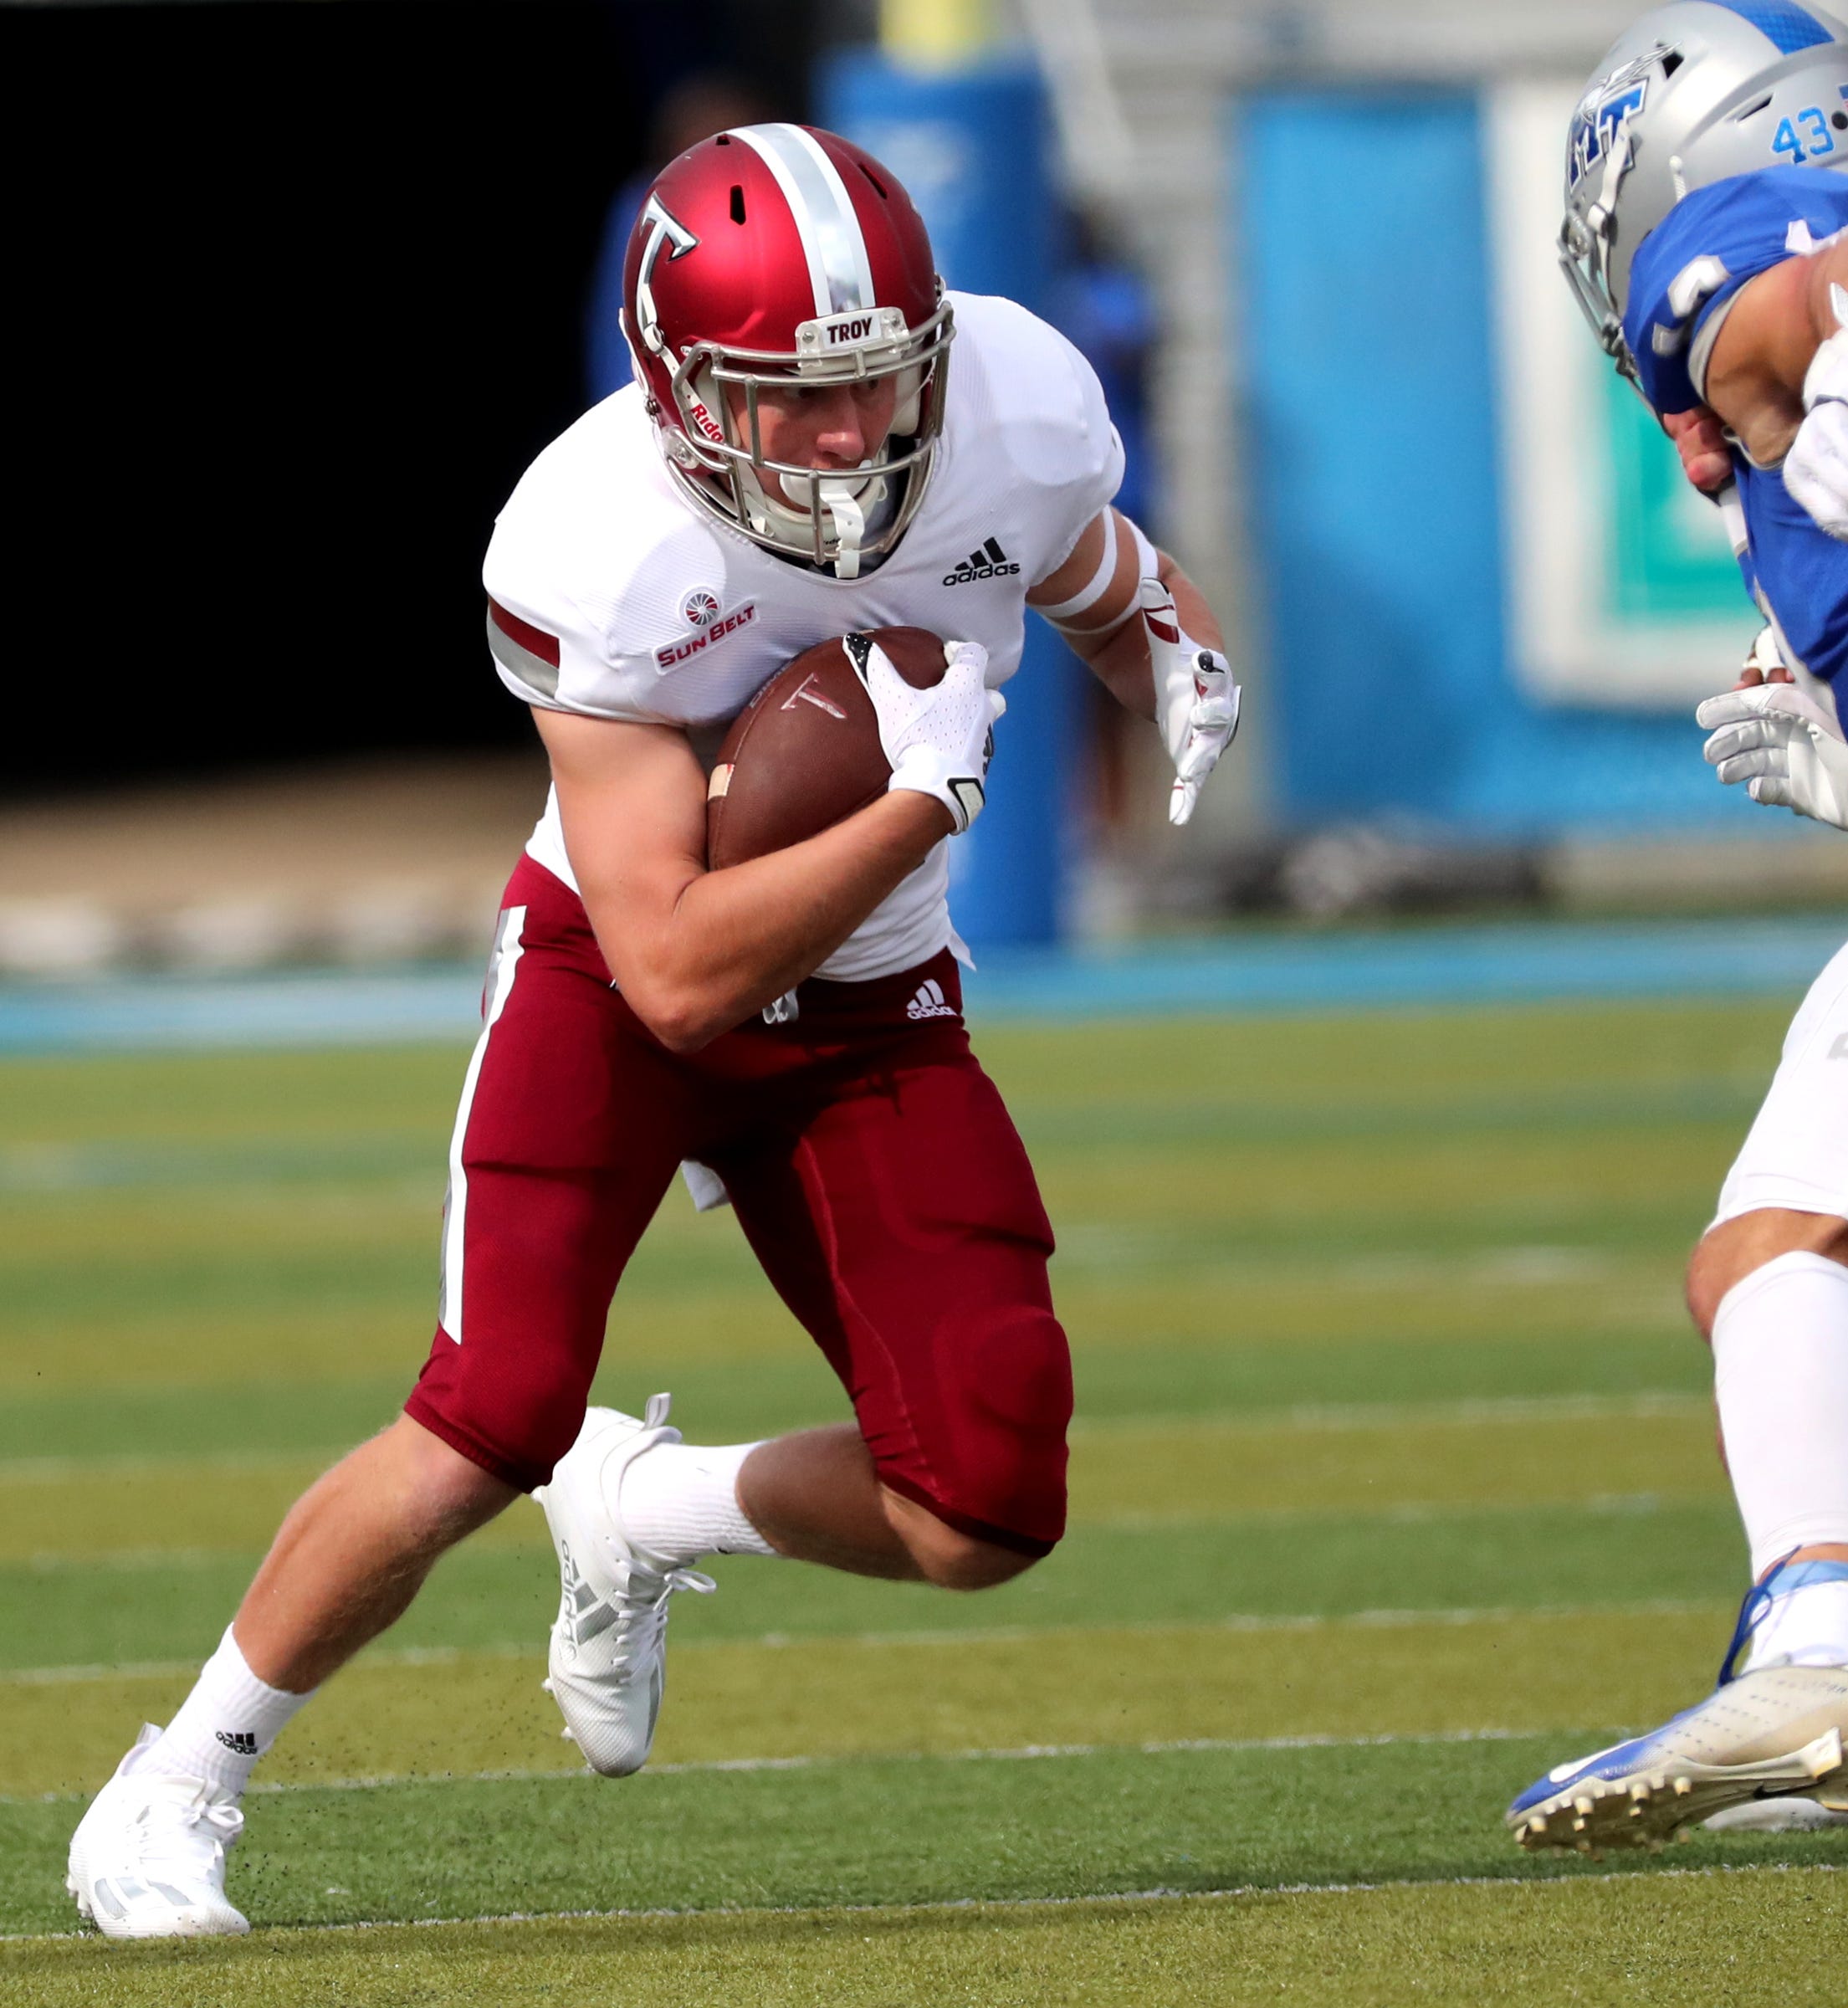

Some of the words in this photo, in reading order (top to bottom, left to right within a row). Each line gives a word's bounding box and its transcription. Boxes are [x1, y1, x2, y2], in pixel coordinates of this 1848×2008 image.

[1771, 106, 1835, 165] 43
[827, 317, 873, 344] TROY
[942, 563, 1021, 587] adidas
[658, 635, 707, 668] SUN
[709, 605, 754, 643] BELT
[907, 1005, 958, 1020] adida
